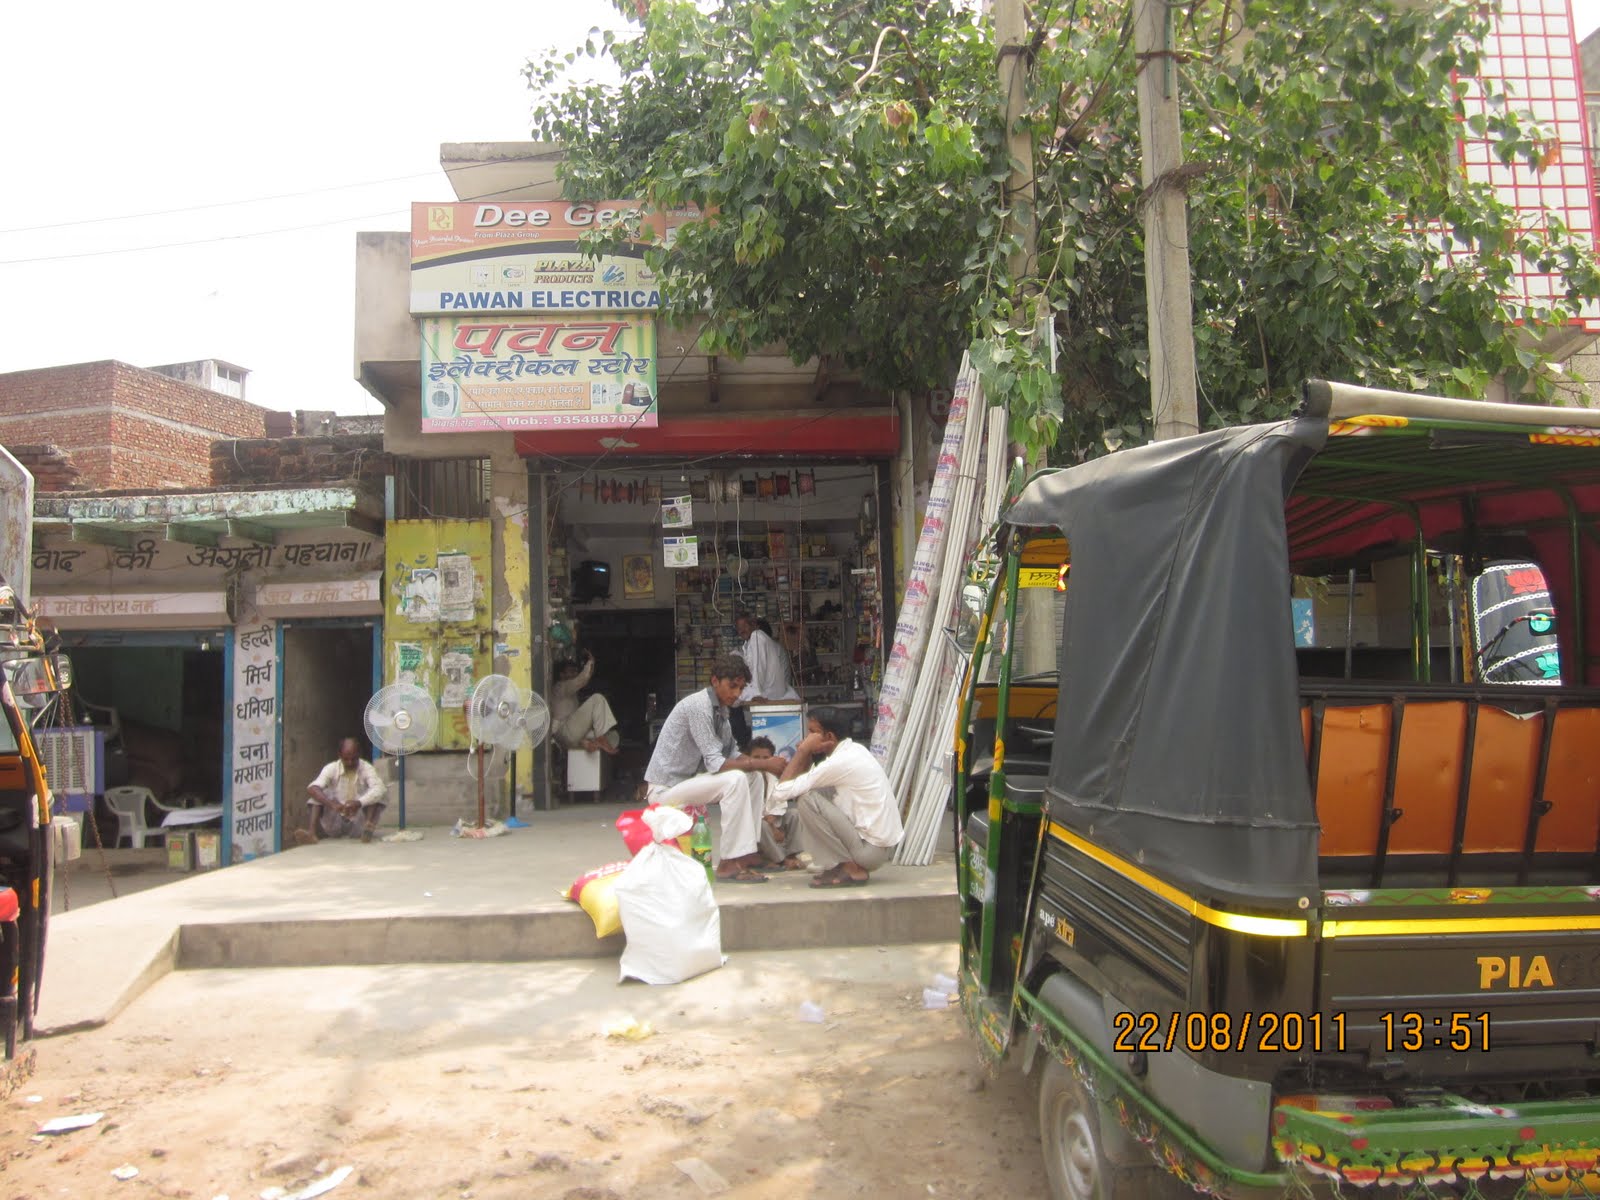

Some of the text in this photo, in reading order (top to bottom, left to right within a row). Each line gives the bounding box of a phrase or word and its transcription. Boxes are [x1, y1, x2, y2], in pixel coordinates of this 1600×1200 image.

[473, 205, 551, 227] Dee
[533, 259, 596, 272] PLAZA
[533, 275, 594, 284] PRODUCTS
[440, 291, 523, 308] PAWAN
[452, 321, 631, 357] पवन
[587, 351, 651, 375] स्टोर
[507, 416, 548, 426] Mob.:
[553, 413, 646, 425] 9354887034
[33, 549, 85, 573] वाद
[113, 539, 160, 571] की
[241, 624, 273, 651] हल्दी
[242, 660, 272, 686] मिर्च
[236, 697, 274, 720] धनिया
[239, 742, 269, 760] चना
[234, 761, 273, 784] मसाला
[235, 793, 267, 814] चाट
[235, 811, 273, 836] मसाला
